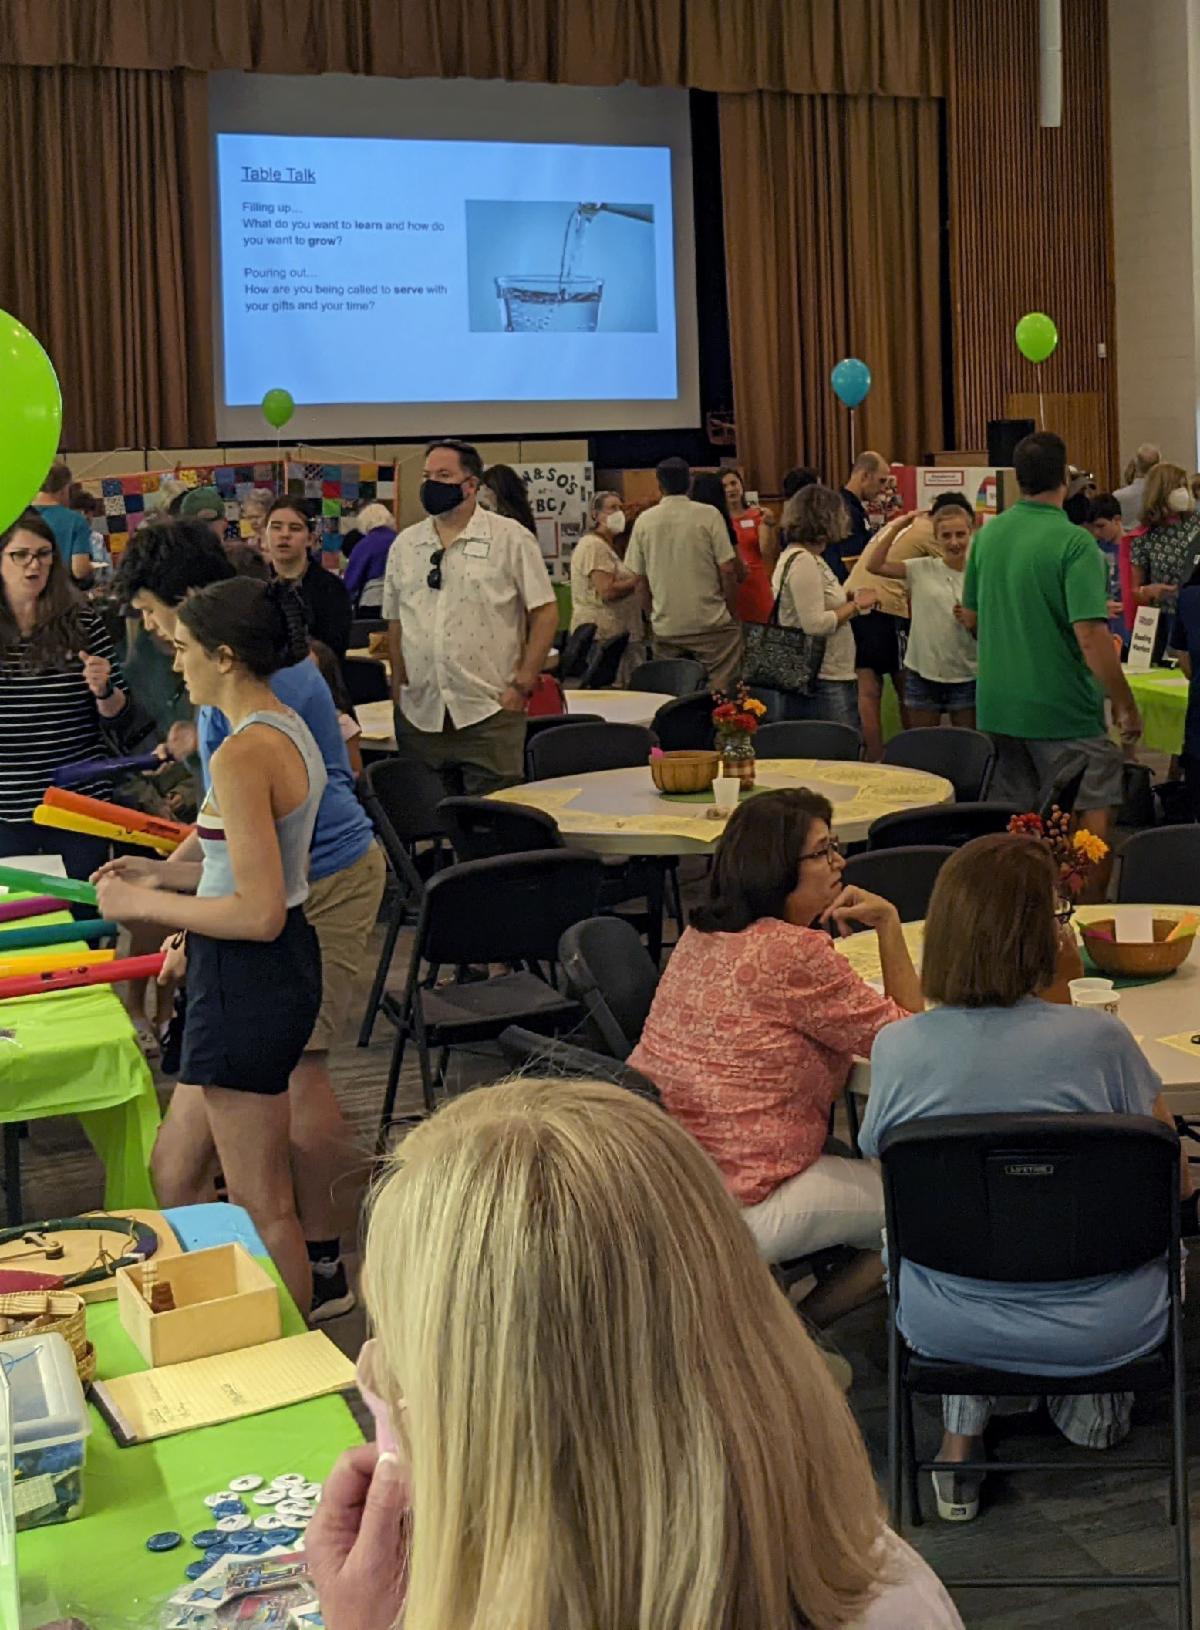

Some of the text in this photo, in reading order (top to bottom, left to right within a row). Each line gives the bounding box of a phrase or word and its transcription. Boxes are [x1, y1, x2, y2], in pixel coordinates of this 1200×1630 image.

[241, 166, 316, 184] Table Talk
[242, 201, 275, 214] Filling
[242, 218, 445, 232] What do you want to learn and how do
[243, 235, 343, 248] you want to grow?
[244, 267, 287, 280] Pouring
[245, 284, 447, 296] How are you being called to serve with
[245, 300, 375, 314] your gifts and your time?
